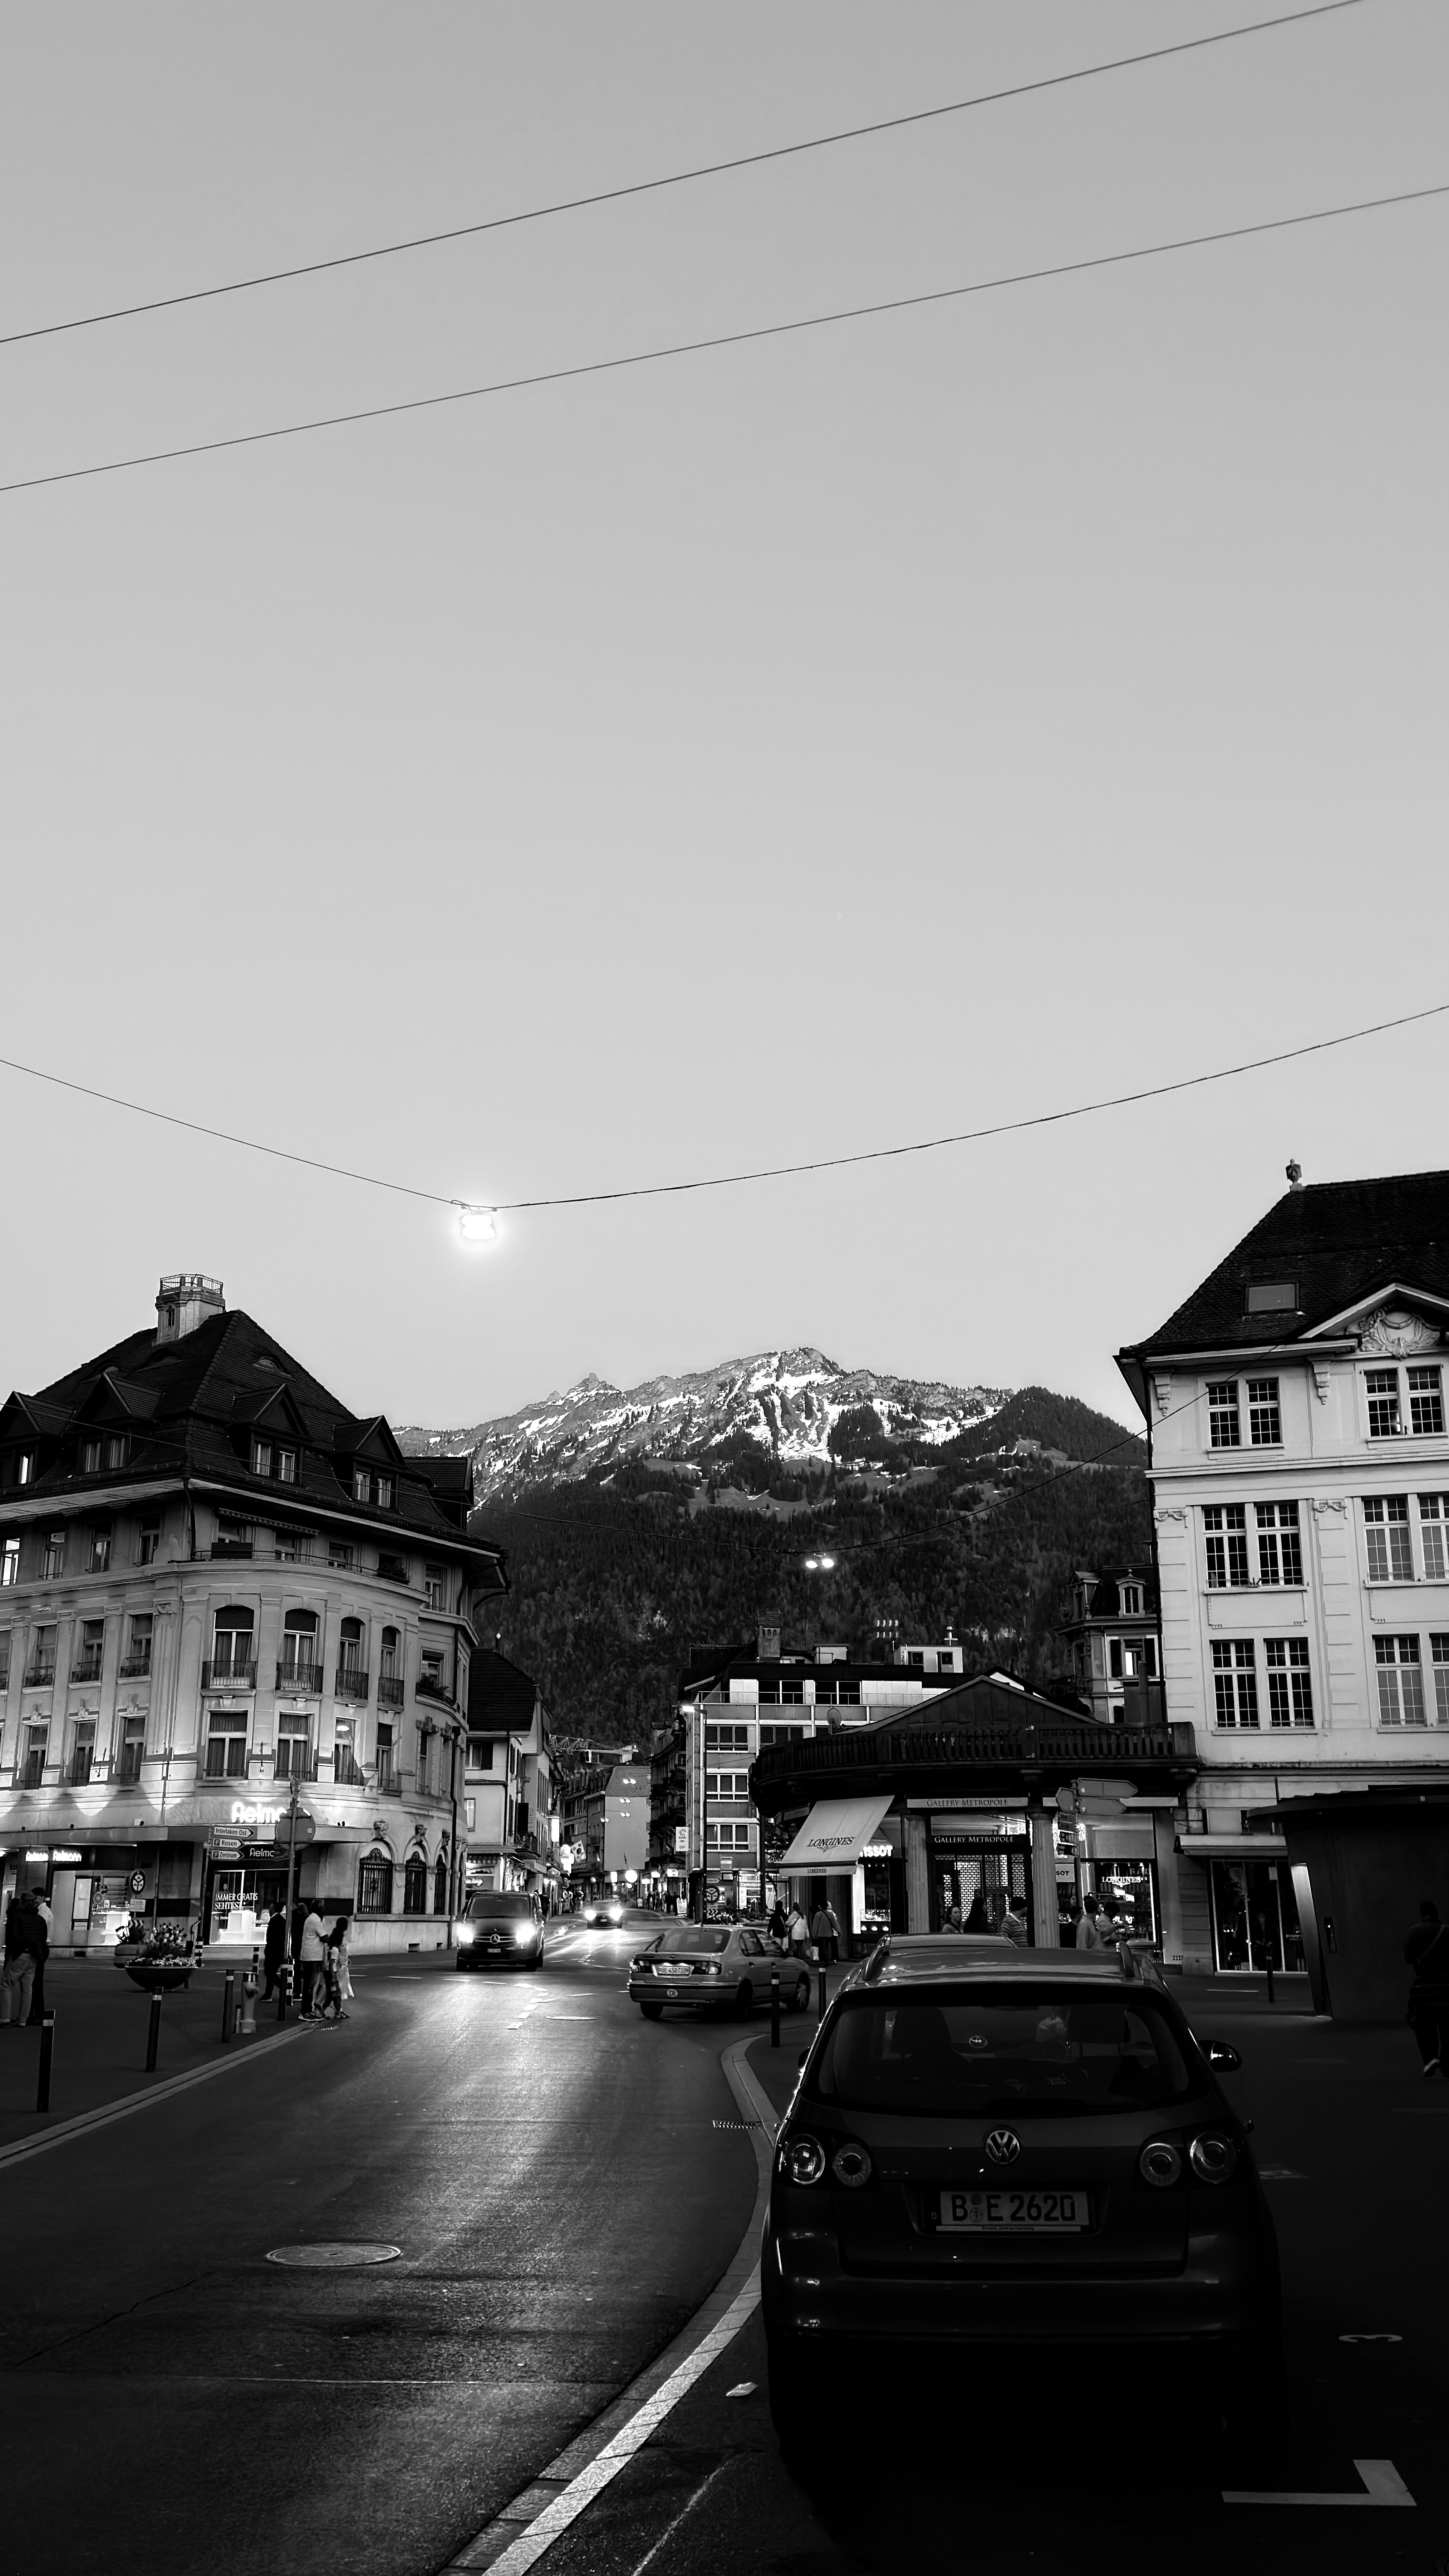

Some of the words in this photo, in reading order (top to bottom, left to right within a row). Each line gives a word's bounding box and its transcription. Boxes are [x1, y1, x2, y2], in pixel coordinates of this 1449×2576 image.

[807, 1837, 854, 1847] LONGINES
[951, 2194, 968, 2221] B
[986, 2194, 1003, 2221] E
[1010, 2194, 1076, 2221] 2620
